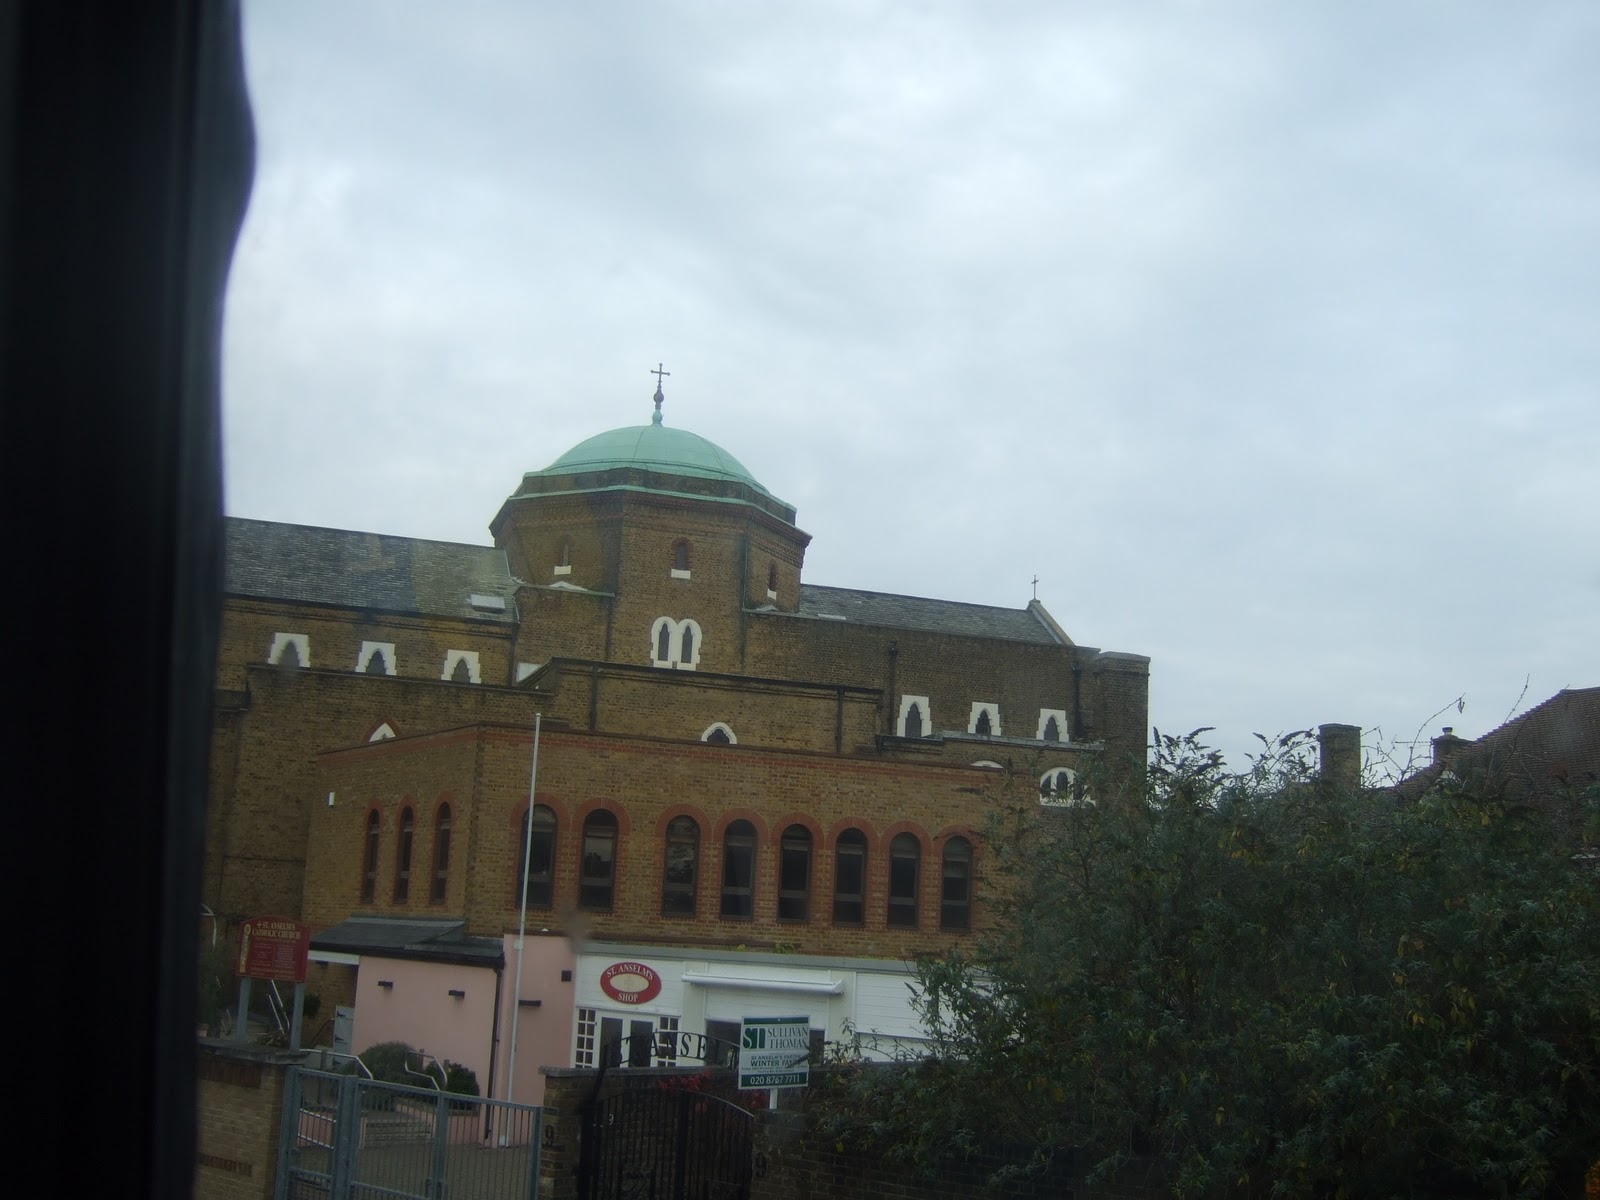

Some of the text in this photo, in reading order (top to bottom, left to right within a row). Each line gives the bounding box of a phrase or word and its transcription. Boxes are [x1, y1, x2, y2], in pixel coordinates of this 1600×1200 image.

[252, 929, 301, 940] CATHOLIC CHURCH
[618, 992, 639, 1003] SHOP
[767, 1027, 808, 1038] SULLIVAN
[769, 1038, 807, 1049] THOMAS
[750, 1074, 800, 1085] 020 8767 7711
